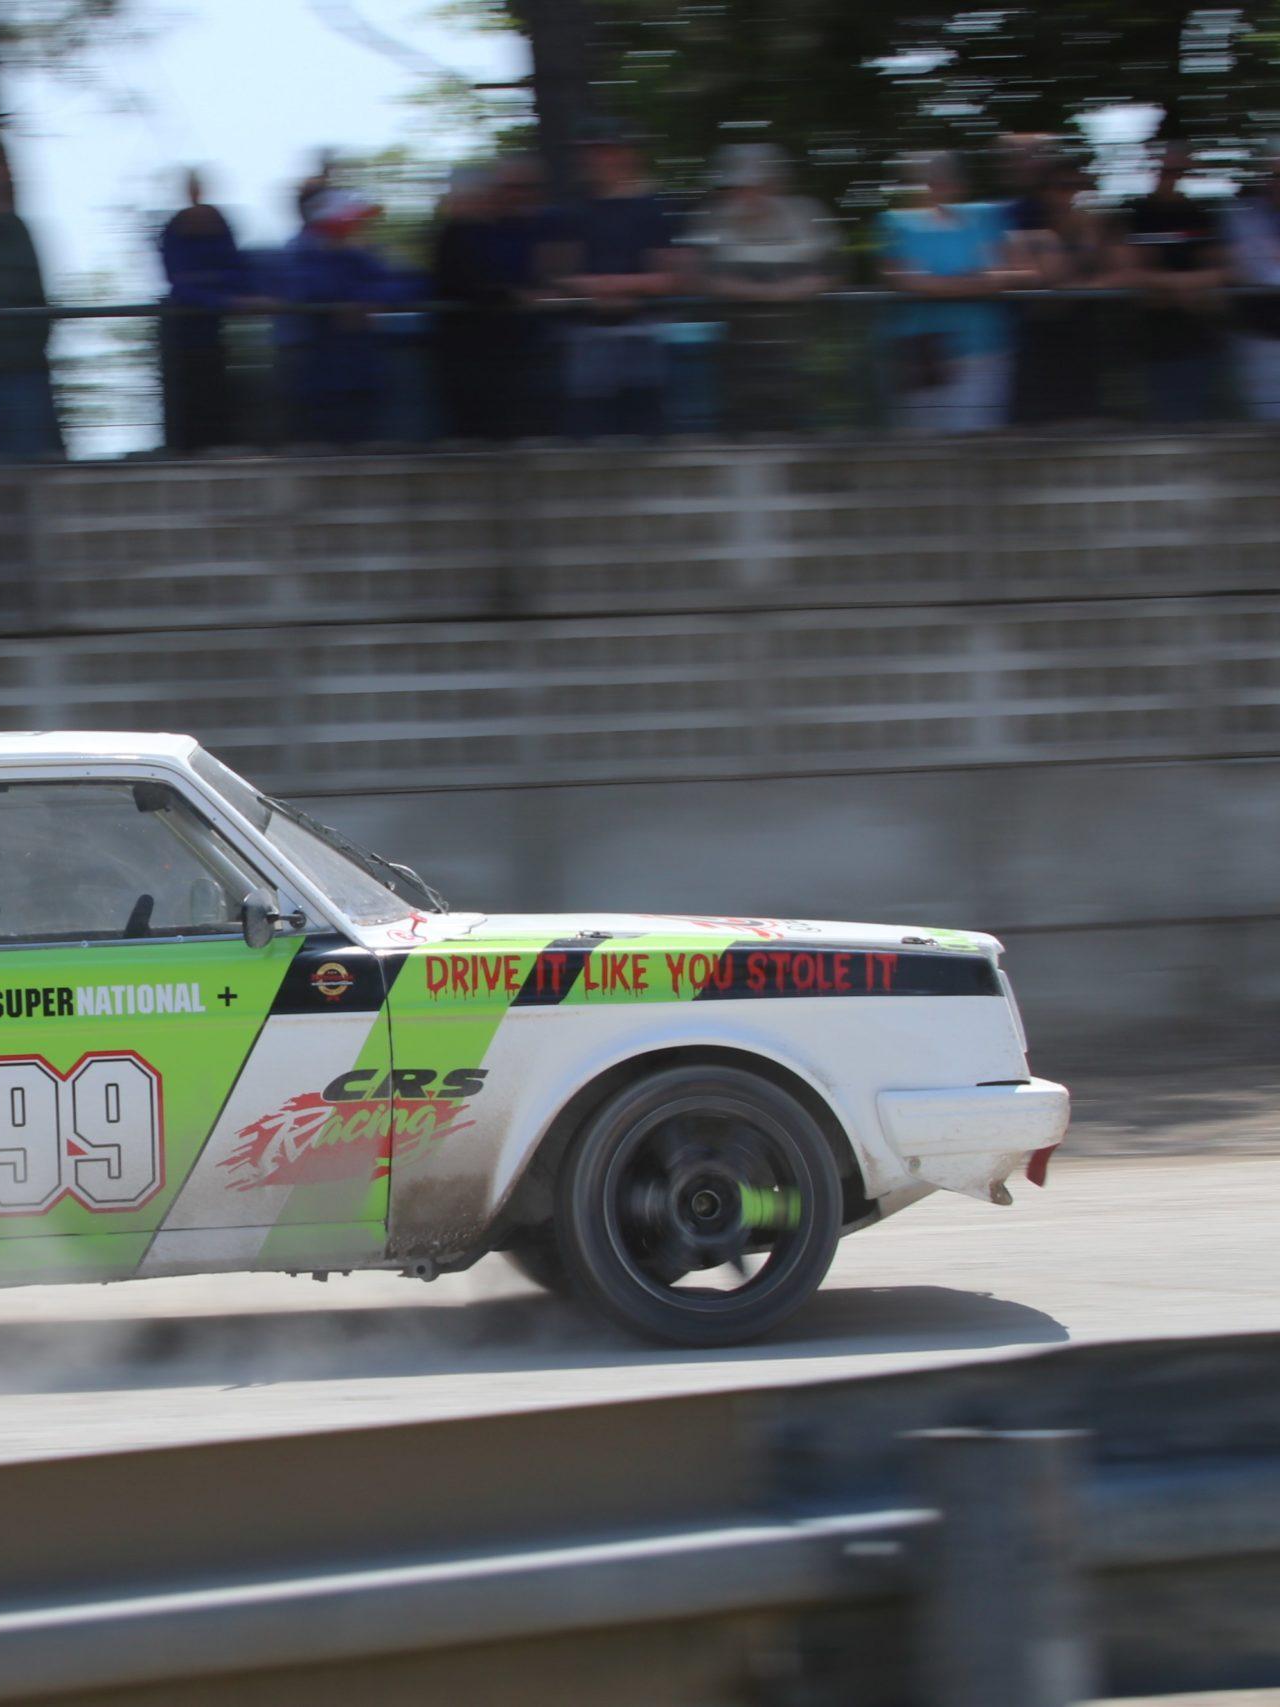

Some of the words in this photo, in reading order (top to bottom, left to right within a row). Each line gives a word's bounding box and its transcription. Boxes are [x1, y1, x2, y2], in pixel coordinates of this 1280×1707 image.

[426, 953, 521, 1001] DRIVE
[536, 952, 568, 996] IT
[584, 952, 650, 1000] LIKE
[665, 953, 734, 999] YOU
[746, 952, 853, 995] STOLE
[864, 953, 899, 992] IT
[322, 1068, 490, 1101] CRS
[253, 1103, 442, 1181] Racing
